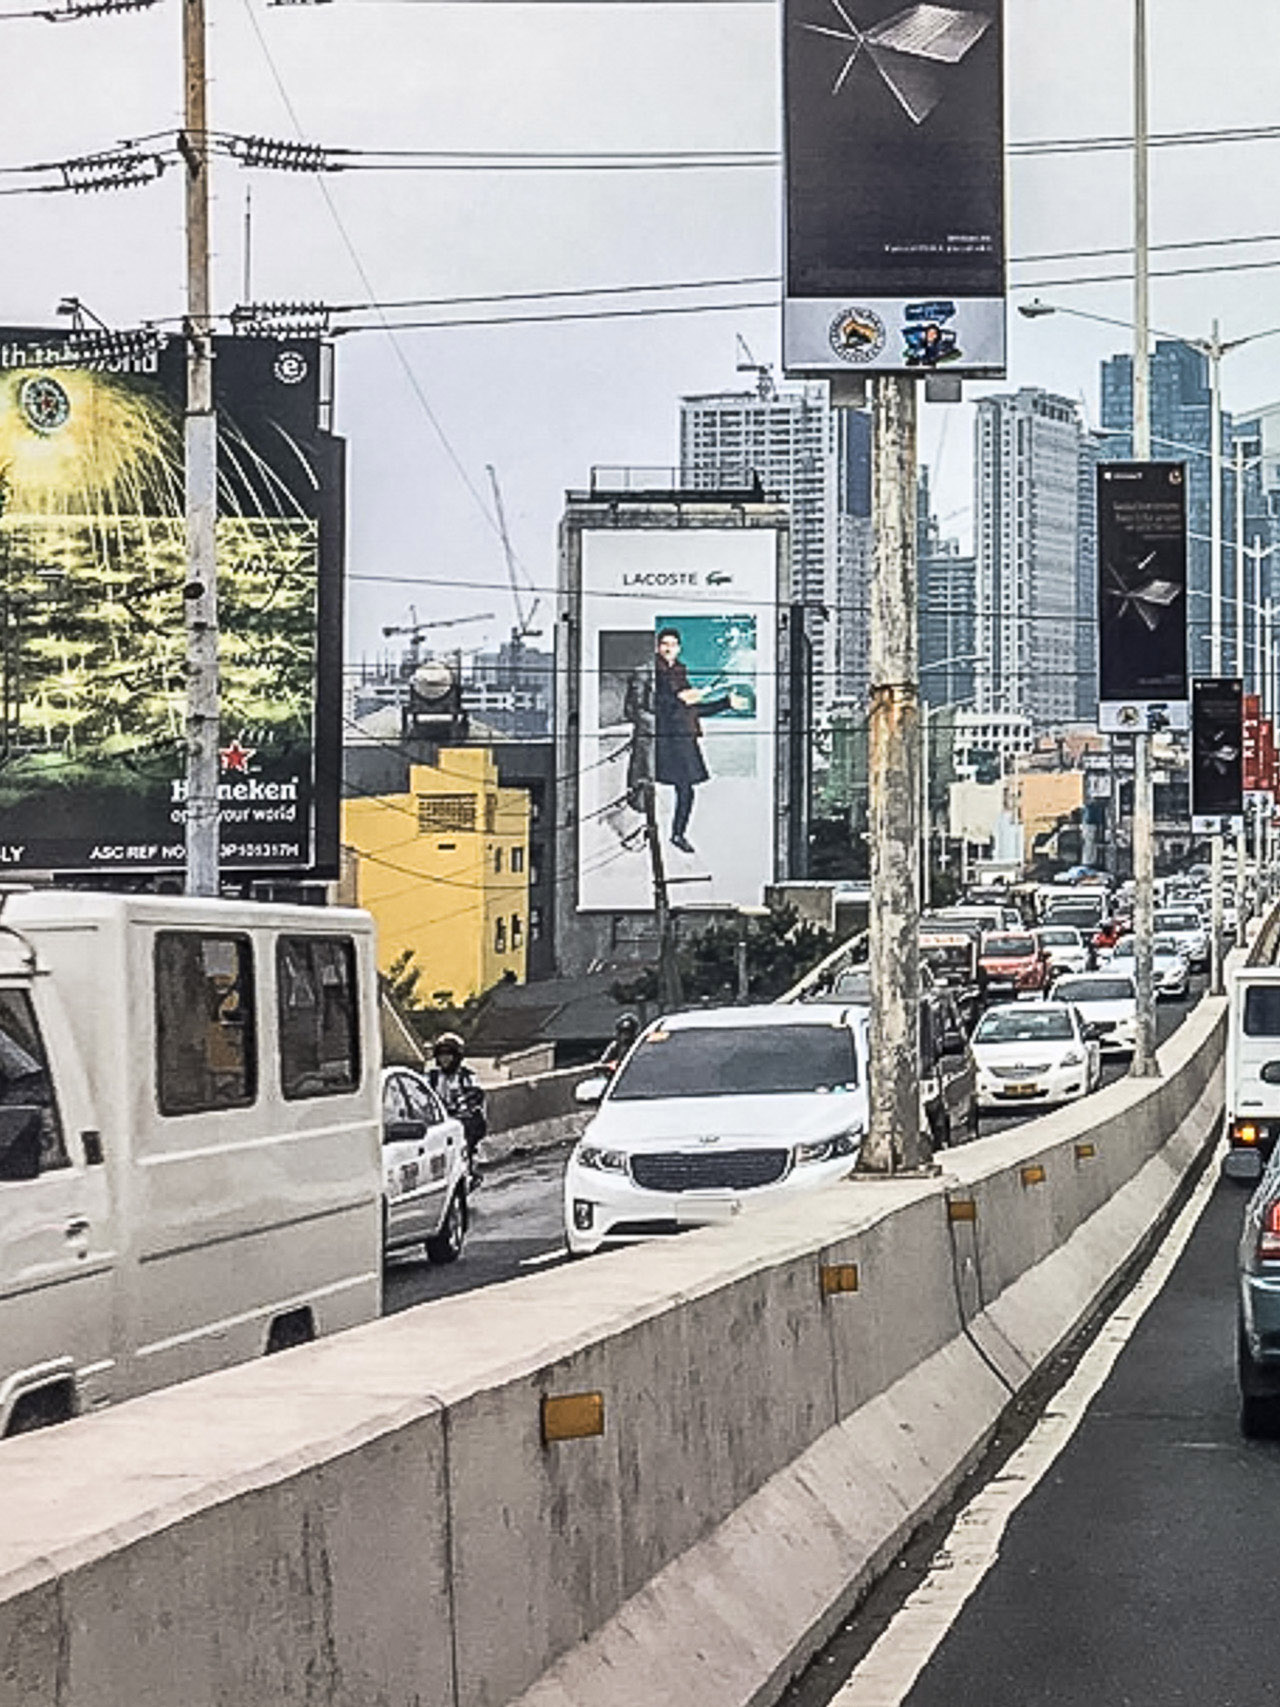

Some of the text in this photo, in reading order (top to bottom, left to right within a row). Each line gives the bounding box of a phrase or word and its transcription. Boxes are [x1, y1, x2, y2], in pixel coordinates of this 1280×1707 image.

[623, 573, 698, 586] LACOSTE
[171, 778, 297, 803] Hneken
[253, 804, 297, 822] world
[89, 846, 124, 860] ASC
